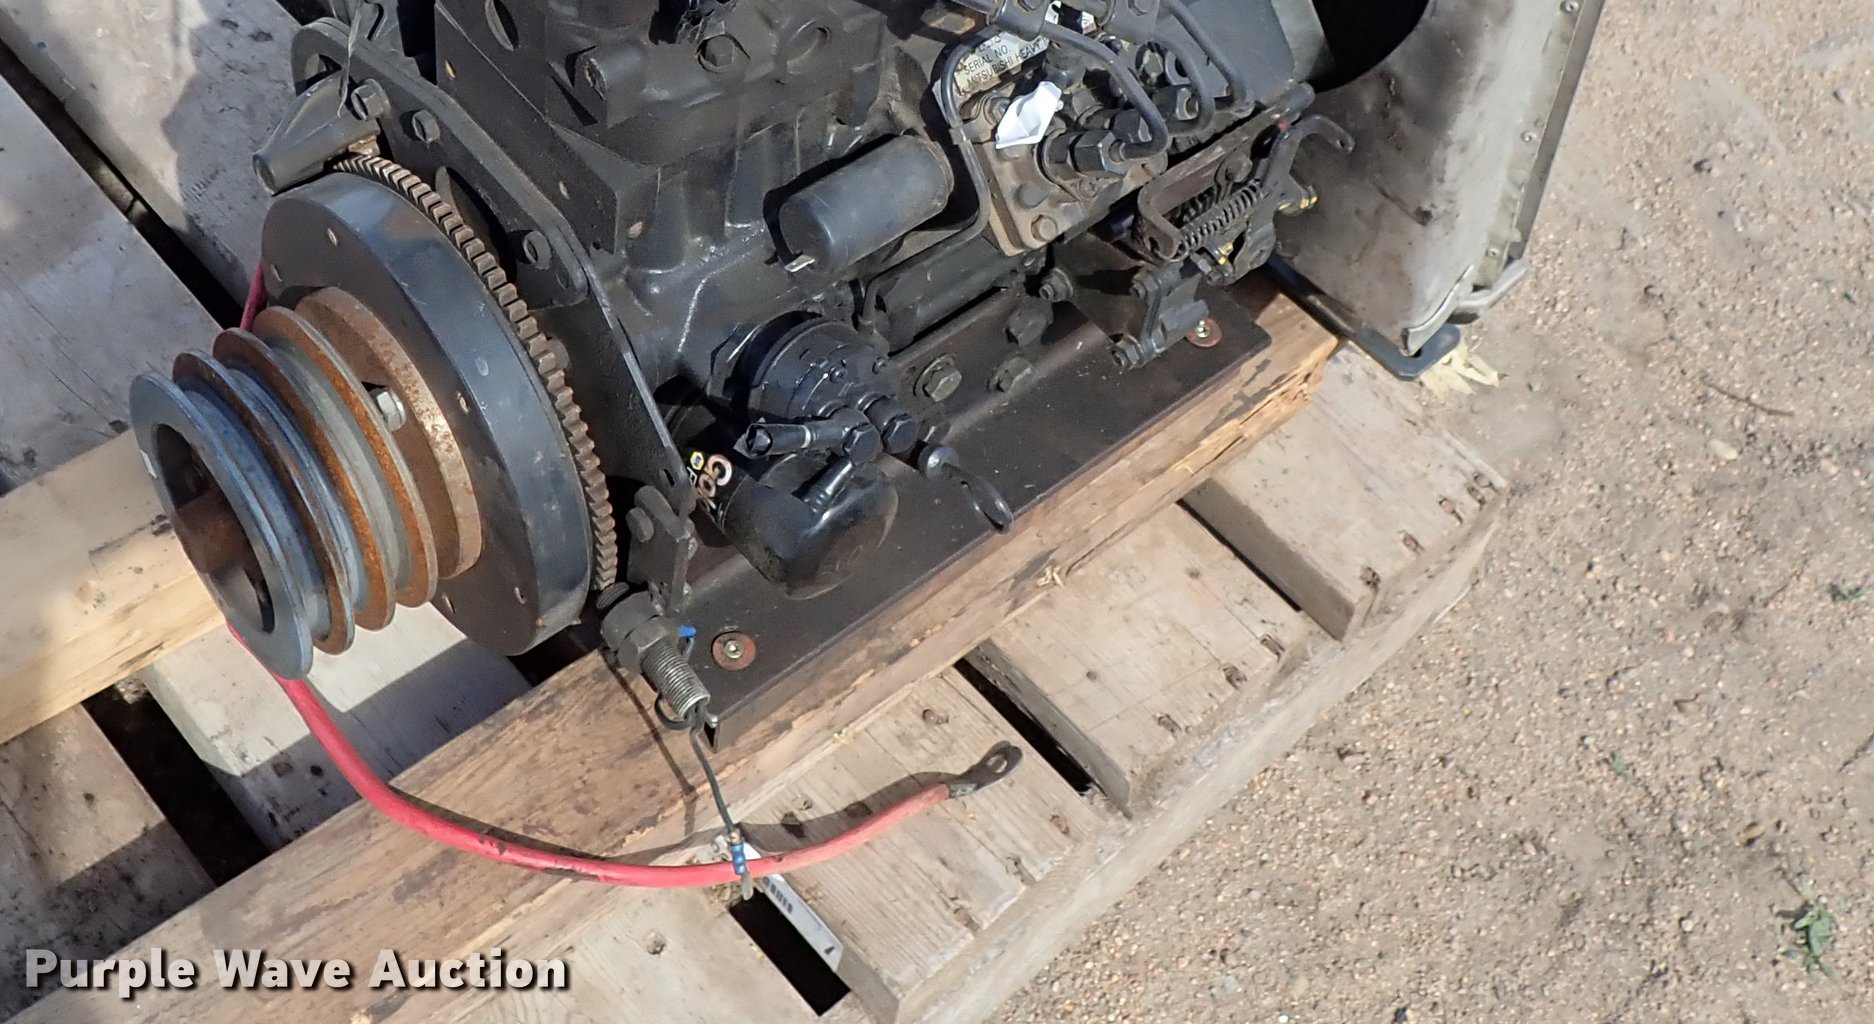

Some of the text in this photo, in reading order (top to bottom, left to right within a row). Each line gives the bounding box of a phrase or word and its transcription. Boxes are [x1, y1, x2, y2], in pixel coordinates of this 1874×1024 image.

[963, 44, 1012, 76] SERIAL NO.
[966, 56, 1014, 88] MITSUBISHI
[1015, 38, 1042, 60] HEAVY
